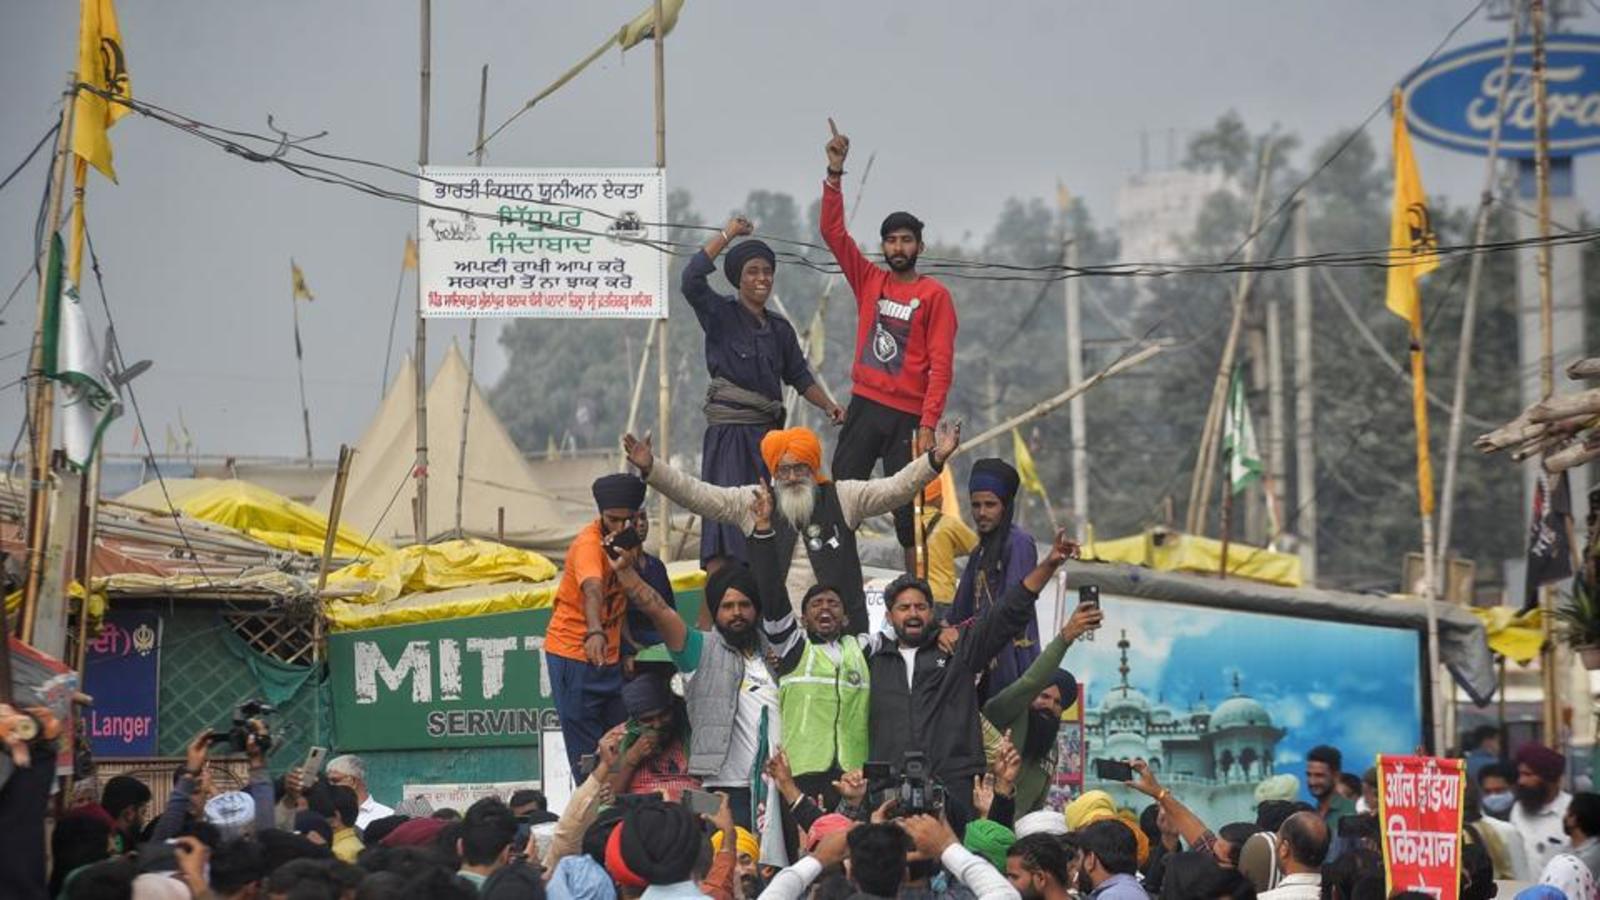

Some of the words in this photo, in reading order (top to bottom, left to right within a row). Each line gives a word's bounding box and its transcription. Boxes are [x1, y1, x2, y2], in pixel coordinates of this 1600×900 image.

[434, 179, 480, 199] ਭਾਰਤੀ
[484, 179, 533, 199] ਕਿਸਾਨ
[537, 179, 598, 203] ਯੂਨੀਅਨ
[601, 179, 644, 199] ਏਕਤਾ
[487, 232, 593, 254] ਜਿੰਦਾਬਾਦ
[453, 257, 507, 273] ਅਪਣੀ
[512, 257, 552, 273] ਰਾਖੀ
[555, 261, 593, 273] ਆਪ
[447, 275, 515, 289] ਸਰਕਾਰਾਂ
[539, 276, 560, 289] ਨਾ
[565, 276, 600, 289] ਝਾਕ
[91, 709, 152, 743] Langer
[427, 707, 561, 737] SERVING
[1386, 813, 1456, 868] किसान
